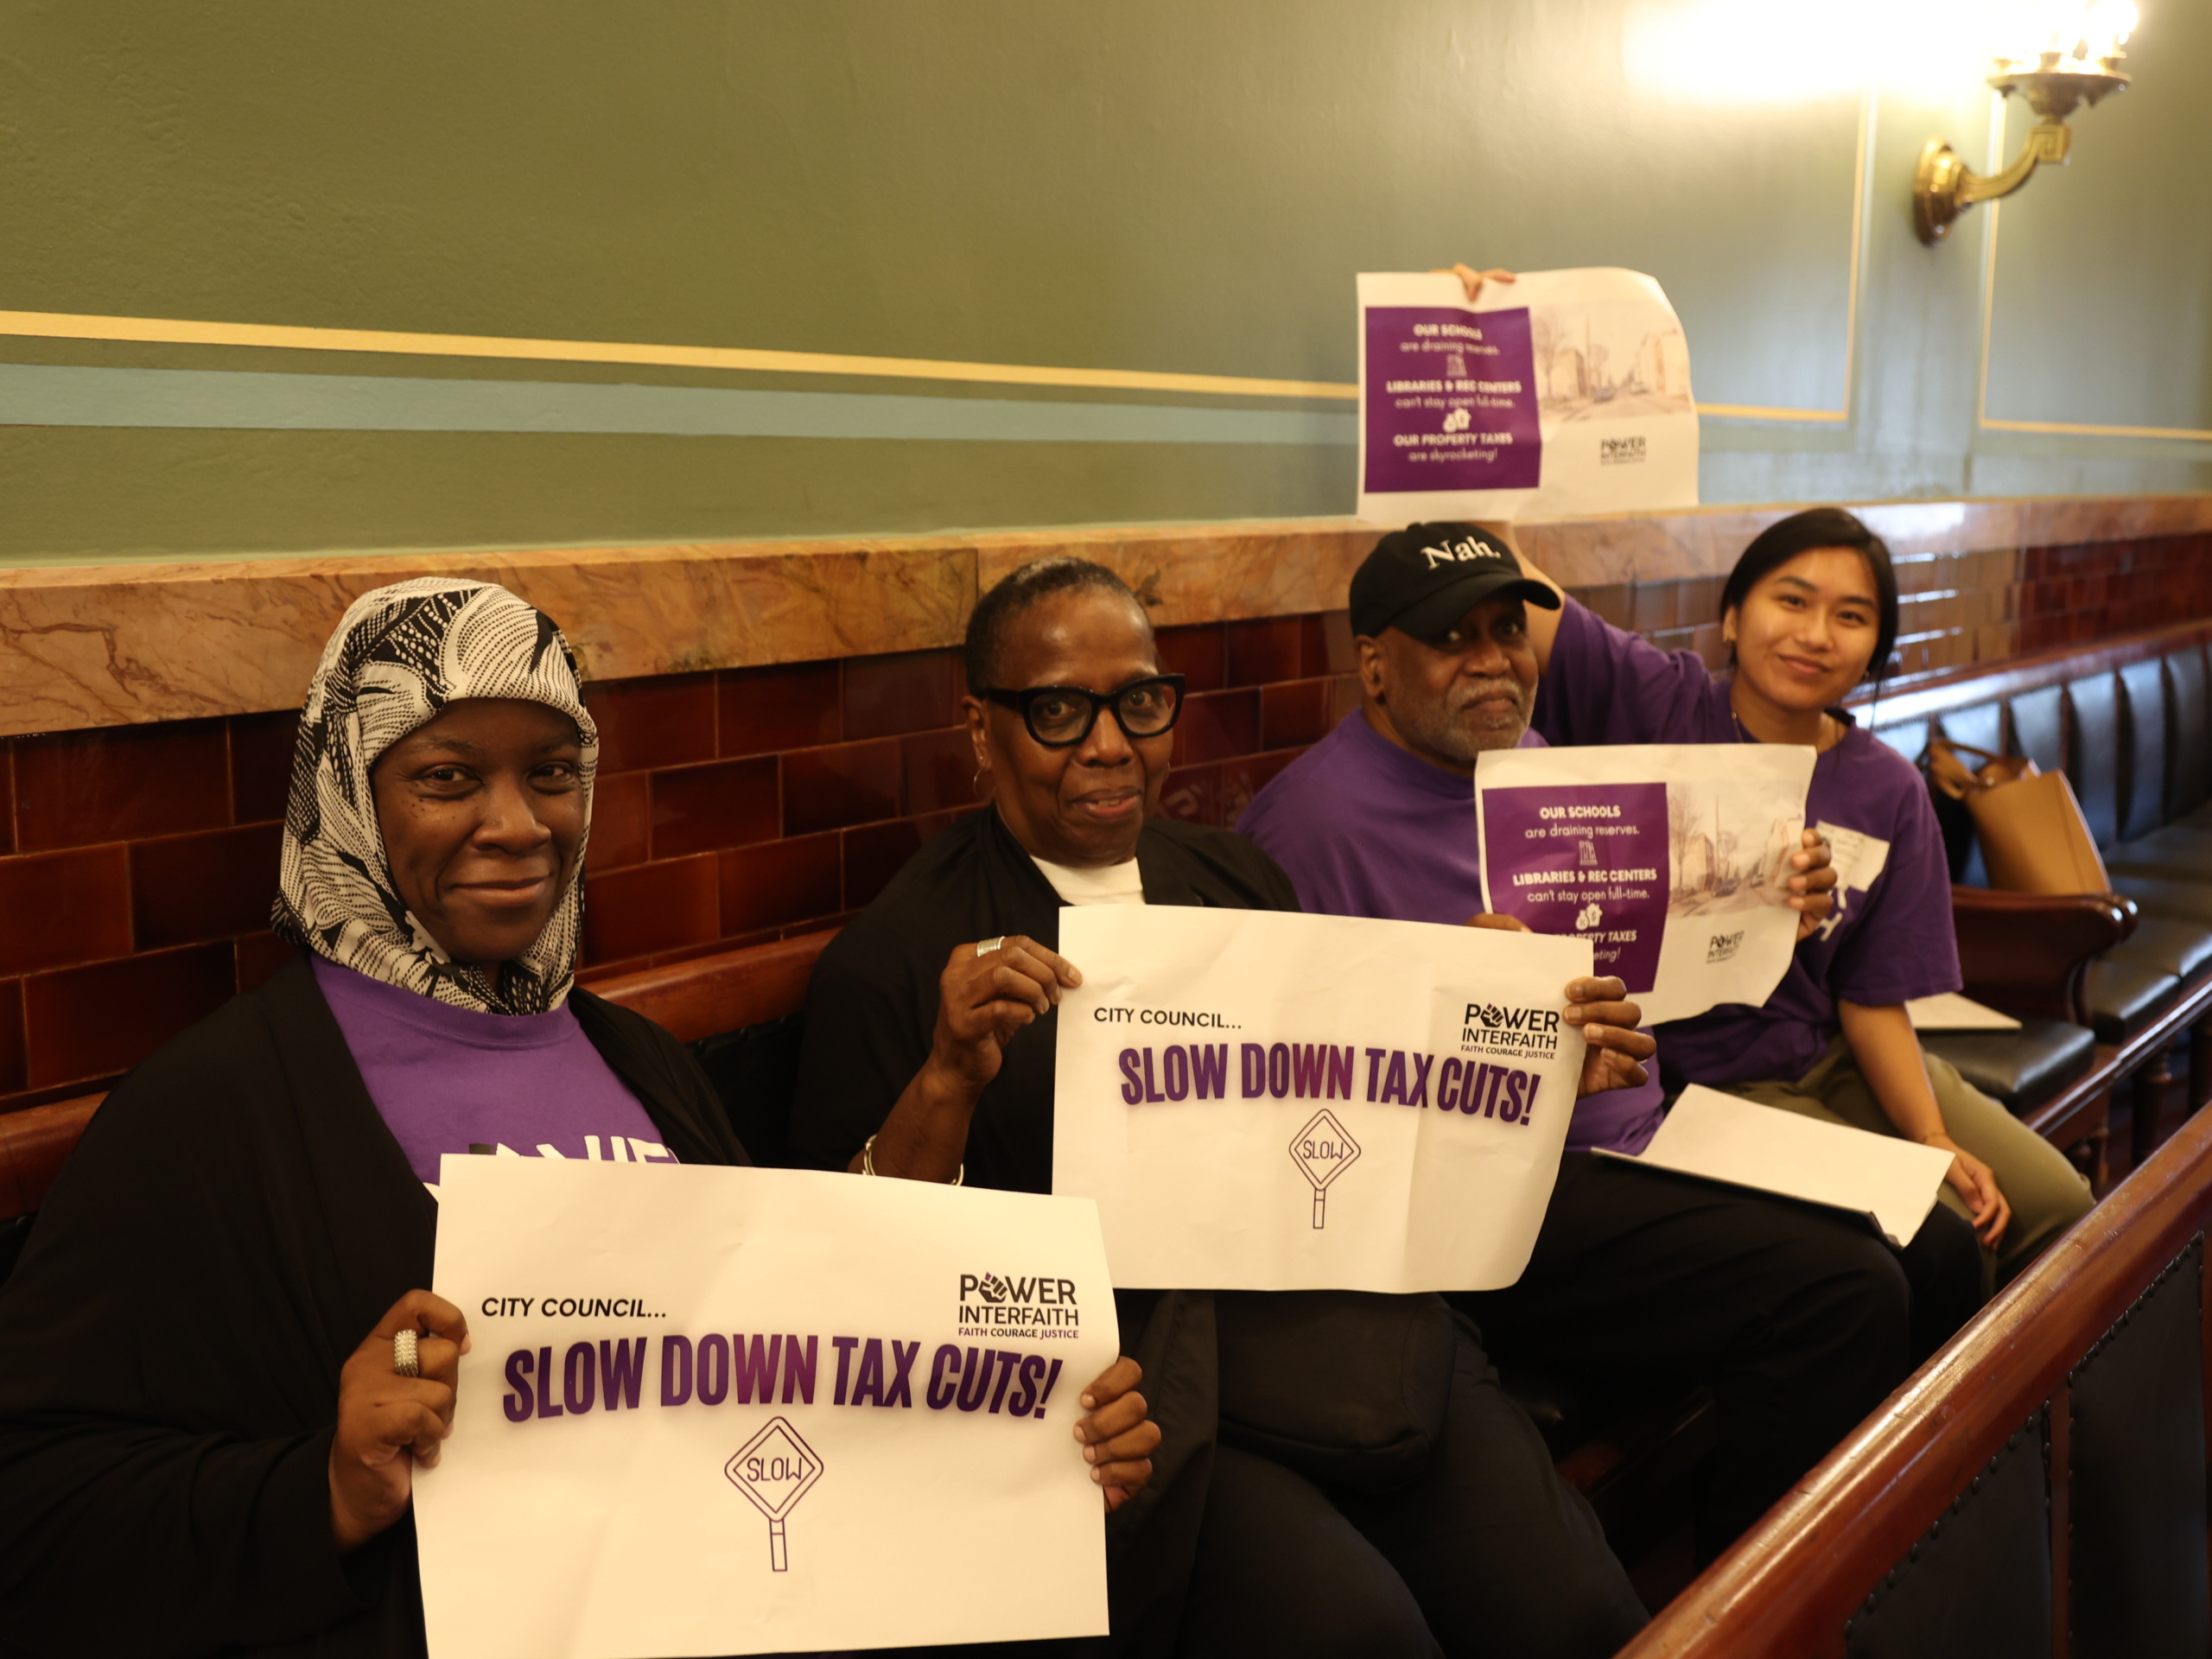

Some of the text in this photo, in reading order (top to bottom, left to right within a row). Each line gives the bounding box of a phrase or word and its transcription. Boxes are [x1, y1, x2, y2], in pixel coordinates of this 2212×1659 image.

[1413, 324, 1483, 340] OUR SCHOOLS
[1400, 342, 1420, 353] are
[1421, 338, 1464, 354] draining
[1386, 380, 1522, 394] LIBRARIES & REC CENTERS
[1423, 397, 1446, 410] stay
[1447, 397, 1475, 410] open
[1393, 432, 1513, 447] OUR PROPERTY TAXES
[1408, 448, 1497, 464] are skyrocketing!
[1421, 536, 1501, 569] Nah.
[1540, 804, 1621, 819] OUR SCHOOLS
[1525, 823, 1640, 839] are draining reserves.
[1513, 868, 1657, 887] LIBRARIES & REC CENTERS
[1528, 886, 1650, 905] can't stay open full-time.
[1608, 930, 1637, 943] TAXES
[1094, 1007, 1242, 1029] CITY COUNCIL...
[1465, 1003, 1560, 1033] POWER
[1462, 1027, 1557, 1050] INTERFAITH
[1461, 1045, 1555, 1059] FAITH COURAGE JUSTICE
[1118, 1042, 1541, 1126] SLOW DOWN TAX CUTS!
[1303, 1140, 1344, 1160] SLOW
[960, 1272, 1077, 1305] POWER
[481, 1297, 666, 1318] CITY COUNCIL...
[959, 1305, 1078, 1326] INTERFAITH
[958, 1327, 1078, 1340] FAITH COURAGE JUSTICE
[503, 1333, 1064, 1422] SLOW DOWN TAX CUTS!
[747, 1457, 802, 1482] SLOW
